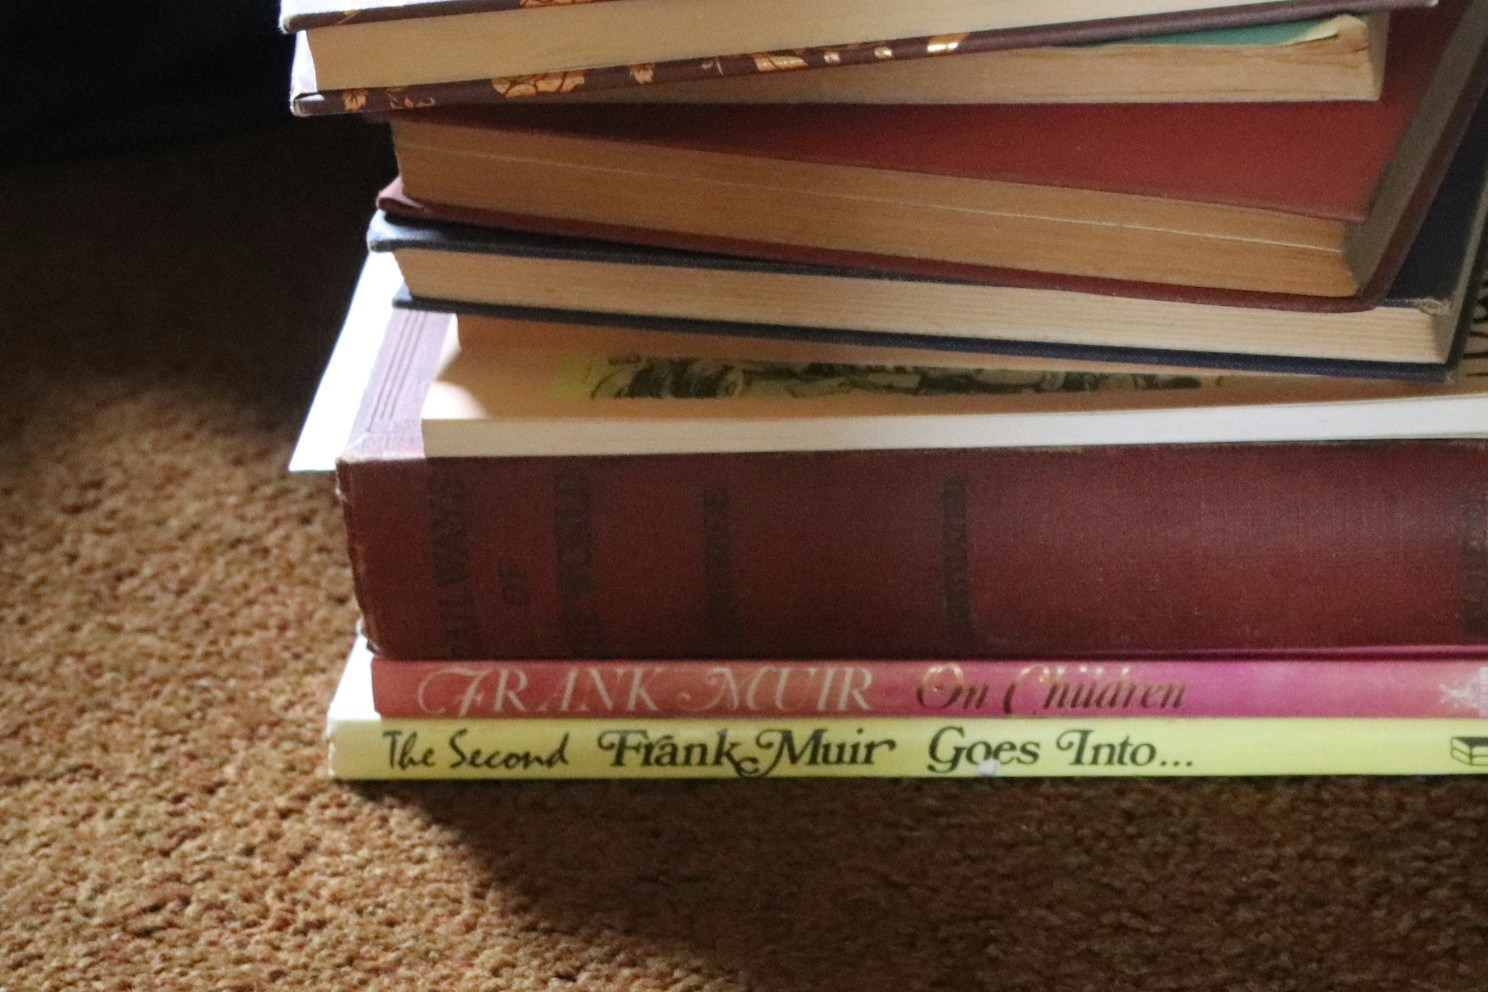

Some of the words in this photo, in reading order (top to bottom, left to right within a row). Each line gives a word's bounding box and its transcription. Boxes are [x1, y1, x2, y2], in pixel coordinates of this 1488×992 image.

[417, 665, 664, 716] FRANK
[678, 665, 874, 714] MUIR
[1003, 663, 1187, 717] Children
[382, 730, 435, 770] The
[449, 730, 570, 771] Second
[597, 727, 762, 776] Frank
[755, 727, 896, 777] Muir
[927, 726, 1041, 774] Goes
[1055, 729, 1195, 770] Into...
